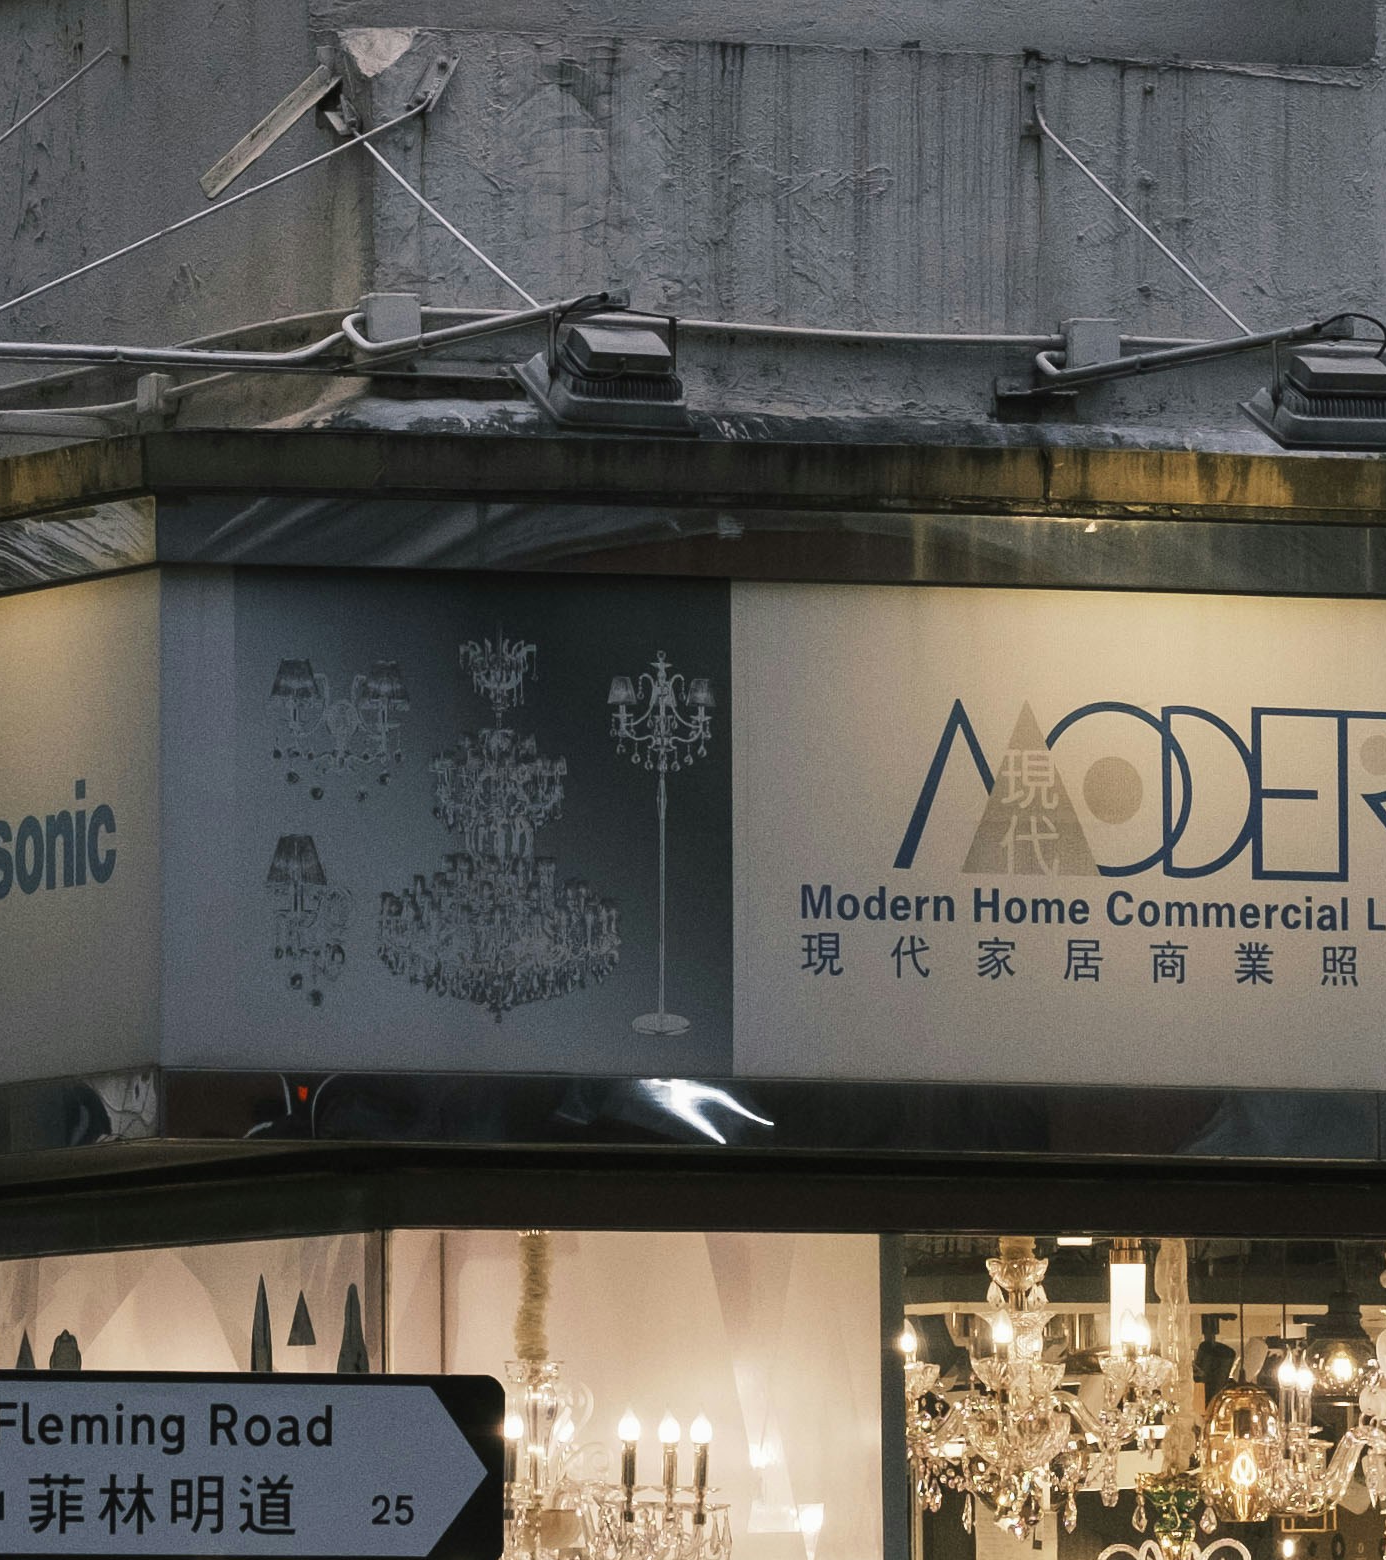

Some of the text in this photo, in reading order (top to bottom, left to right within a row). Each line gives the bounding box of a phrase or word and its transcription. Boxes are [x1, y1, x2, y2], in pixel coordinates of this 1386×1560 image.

[1001, 749, 1059, 878] 現代
[801, 884, 955, 922] Modern
[974, 888, 1090, 925] Home
[1106, 890, 1349, 931] Commercial
[209, 1403, 334, 1447] Road
[27, 1473, 297, 1536] 菲林明道
[370, 1496, 415, 1526] 25
